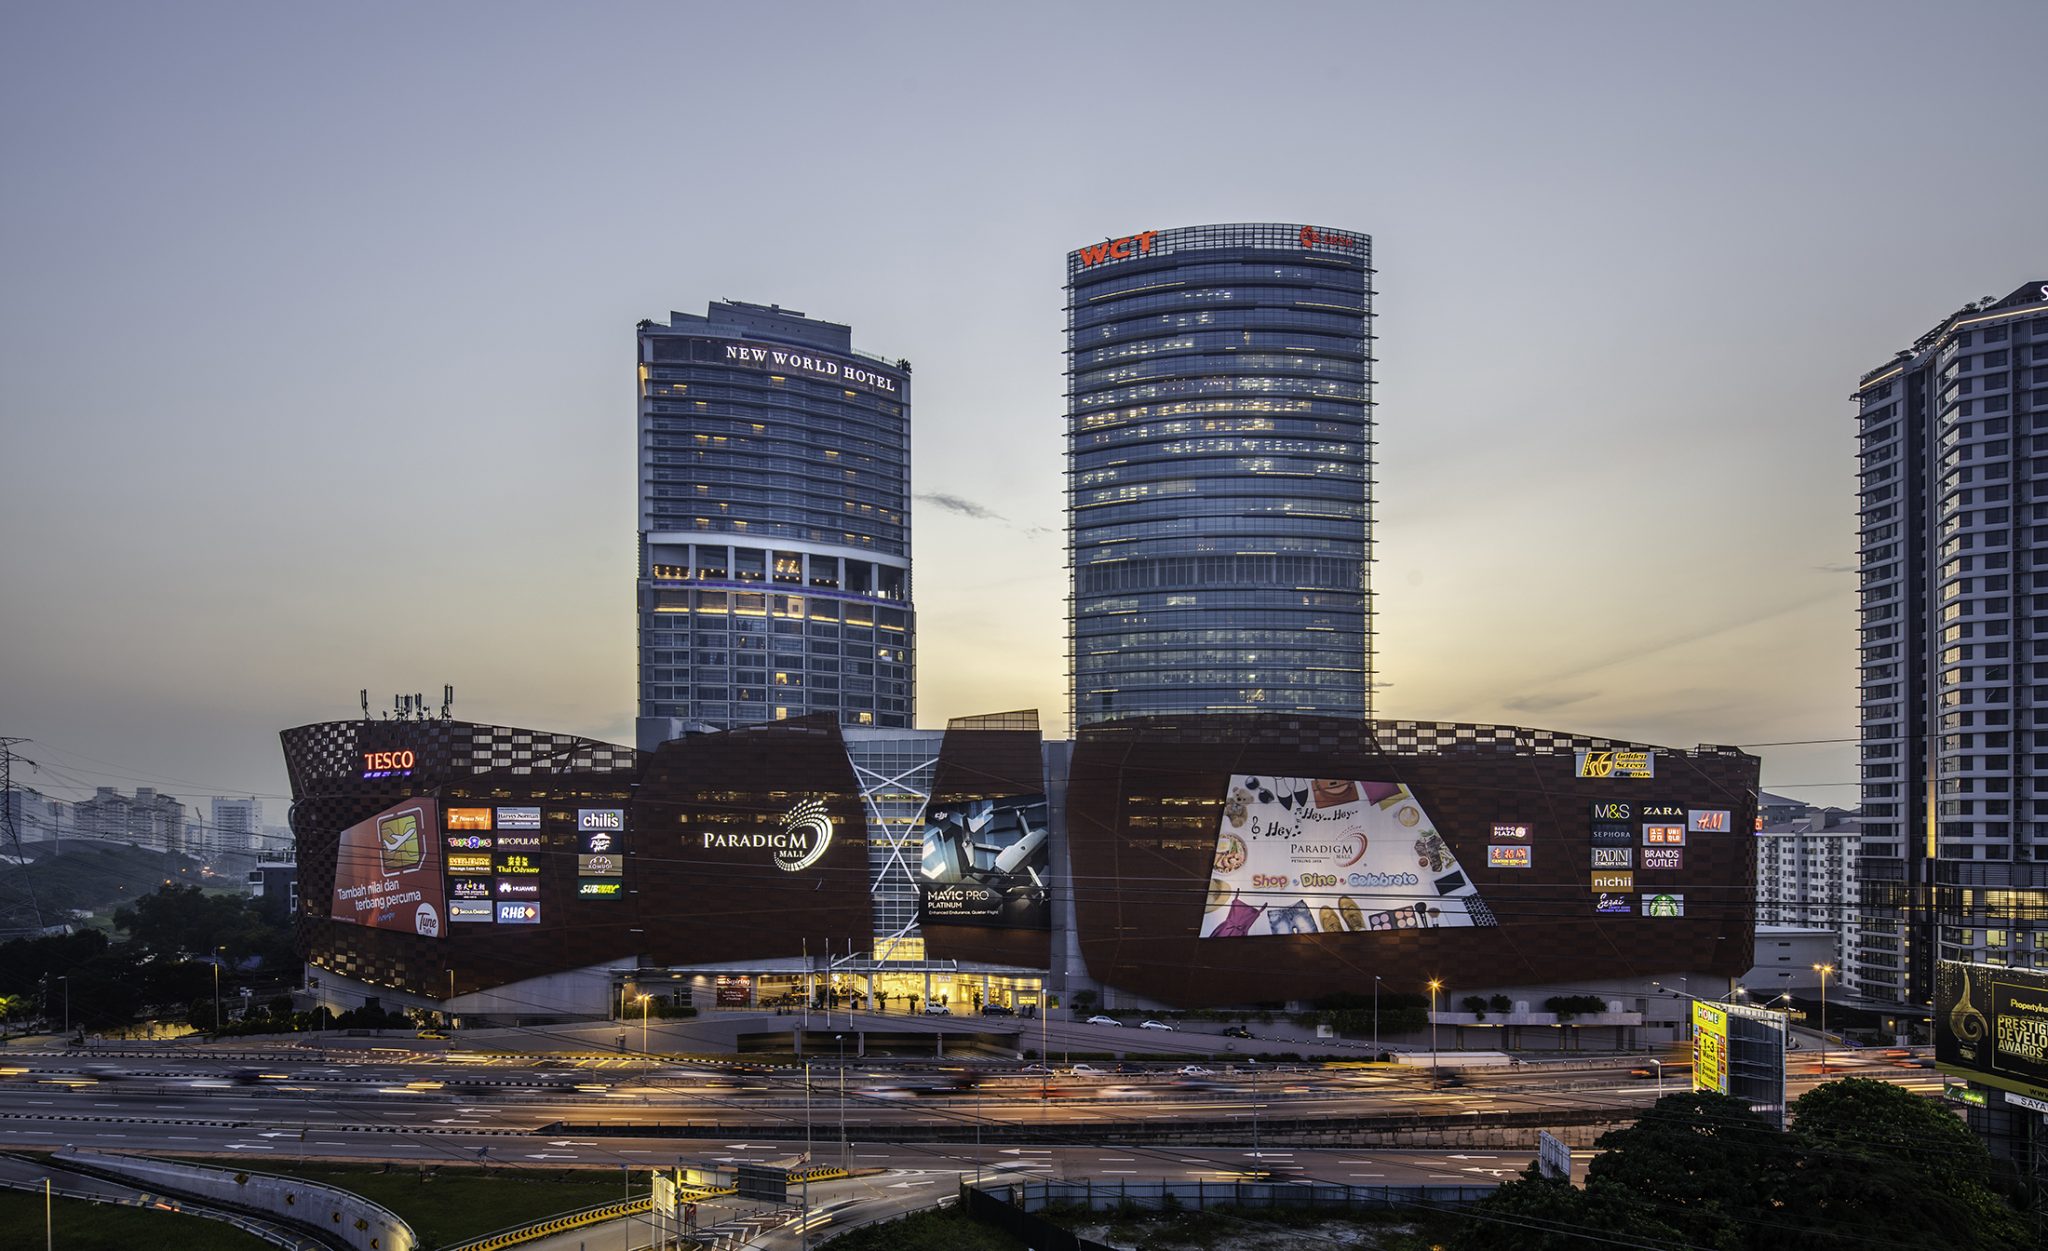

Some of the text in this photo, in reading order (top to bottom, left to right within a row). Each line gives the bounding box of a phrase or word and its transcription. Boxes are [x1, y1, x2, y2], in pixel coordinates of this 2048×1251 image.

[1080, 230, 1157, 267] WCT
[726, 346, 895, 391] NEW WORLD HOTEL
[364, 750, 414, 770] TESCO
[1616, 752, 1647, 760] Golden
[1614, 761, 1647, 769] Screen
[1594, 803, 1630, 819] M&S
[1643, 807, 1683, 815] ZARA
[1697, 812, 1723, 830] H&M
[504, 837, 540, 845] POPULAR
[703, 832, 808, 849] PARADIGM
[779, 850, 805, 858] MALL
[1290, 844, 1353, 855] PARADIGM
[1595, 849, 1629, 862] PADINI
[1644, 849, 1680, 858] BRANDS
[497, 865, 540, 874] Thai Odyssey
[1646, 859, 1678, 868] OUTLET
[1252, 871, 1418, 890] Shop Dine Celebrate
[1594, 876, 1632, 887] nichii
[337, 879, 400, 900] Tambah nilai dan
[580, 884, 620, 894] SUBWAY
[927, 890, 989, 901] MAVIC PRO
[355, 890, 421, 910] terbang percuma
[927, 901, 963, 909] PLATINUM
[501, 906, 526, 919] RHB
[417, 911, 438, 931] Tune
[1697, 1005, 1719, 1025] HOME
[1997, 1016, 2048, 1036] PRESTIG
[1997, 1039, 2044, 1058] AWARDS
